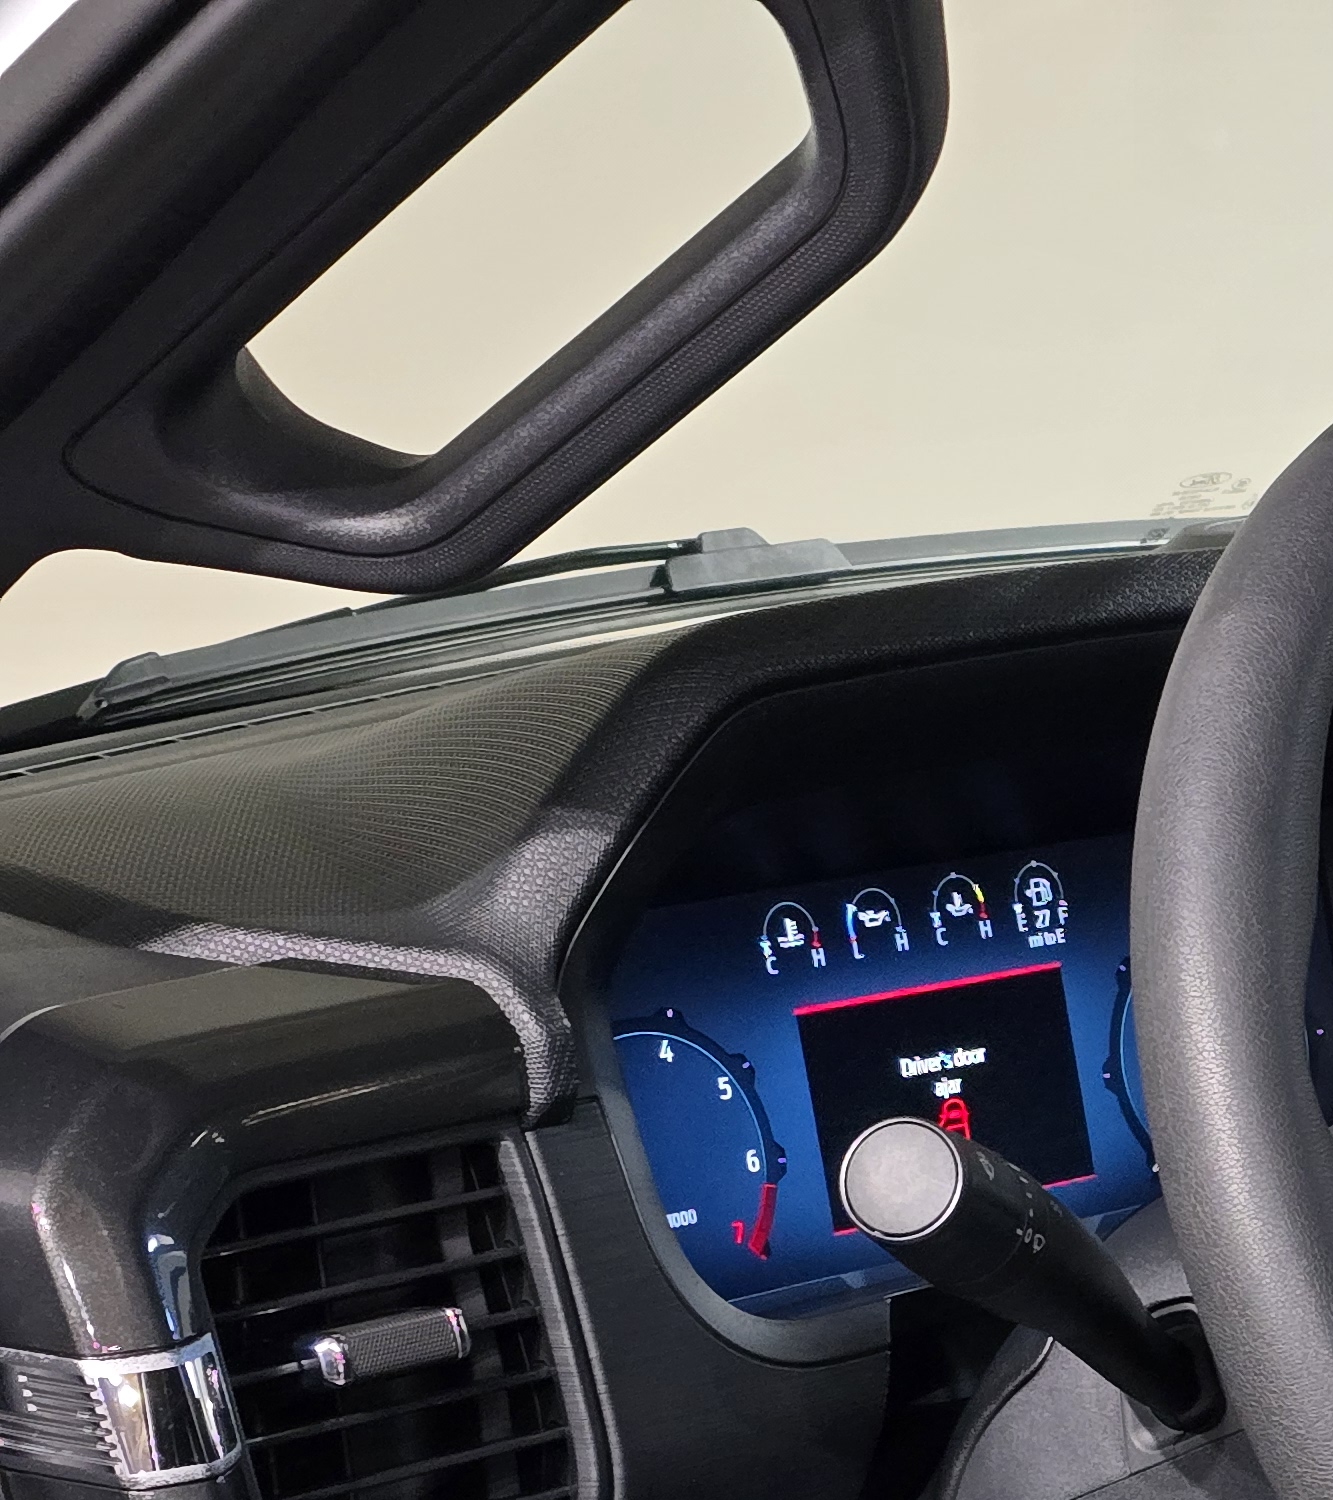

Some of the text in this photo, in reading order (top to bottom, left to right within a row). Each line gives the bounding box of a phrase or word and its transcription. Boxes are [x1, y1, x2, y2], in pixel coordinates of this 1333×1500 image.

[1016, 913, 1029, 933] E
[1057, 905, 1068, 926] F
[935, 927, 949, 946] C
[978, 919, 994, 939] H
[852, 941, 865, 959] L
[894, 932, 910, 952] H
[766, 956, 779, 975] C
[811, 948, 827, 968] H
[658, 1039, 674, 1062] 4
[899, 1047, 986, 1078] Driver's door
[717, 1076, 733, 1100] 5
[934, 1077, 962, 1099] ajar
[746, 1149, 760, 1172] 6
[731, 1220, 745, 1244] 7
